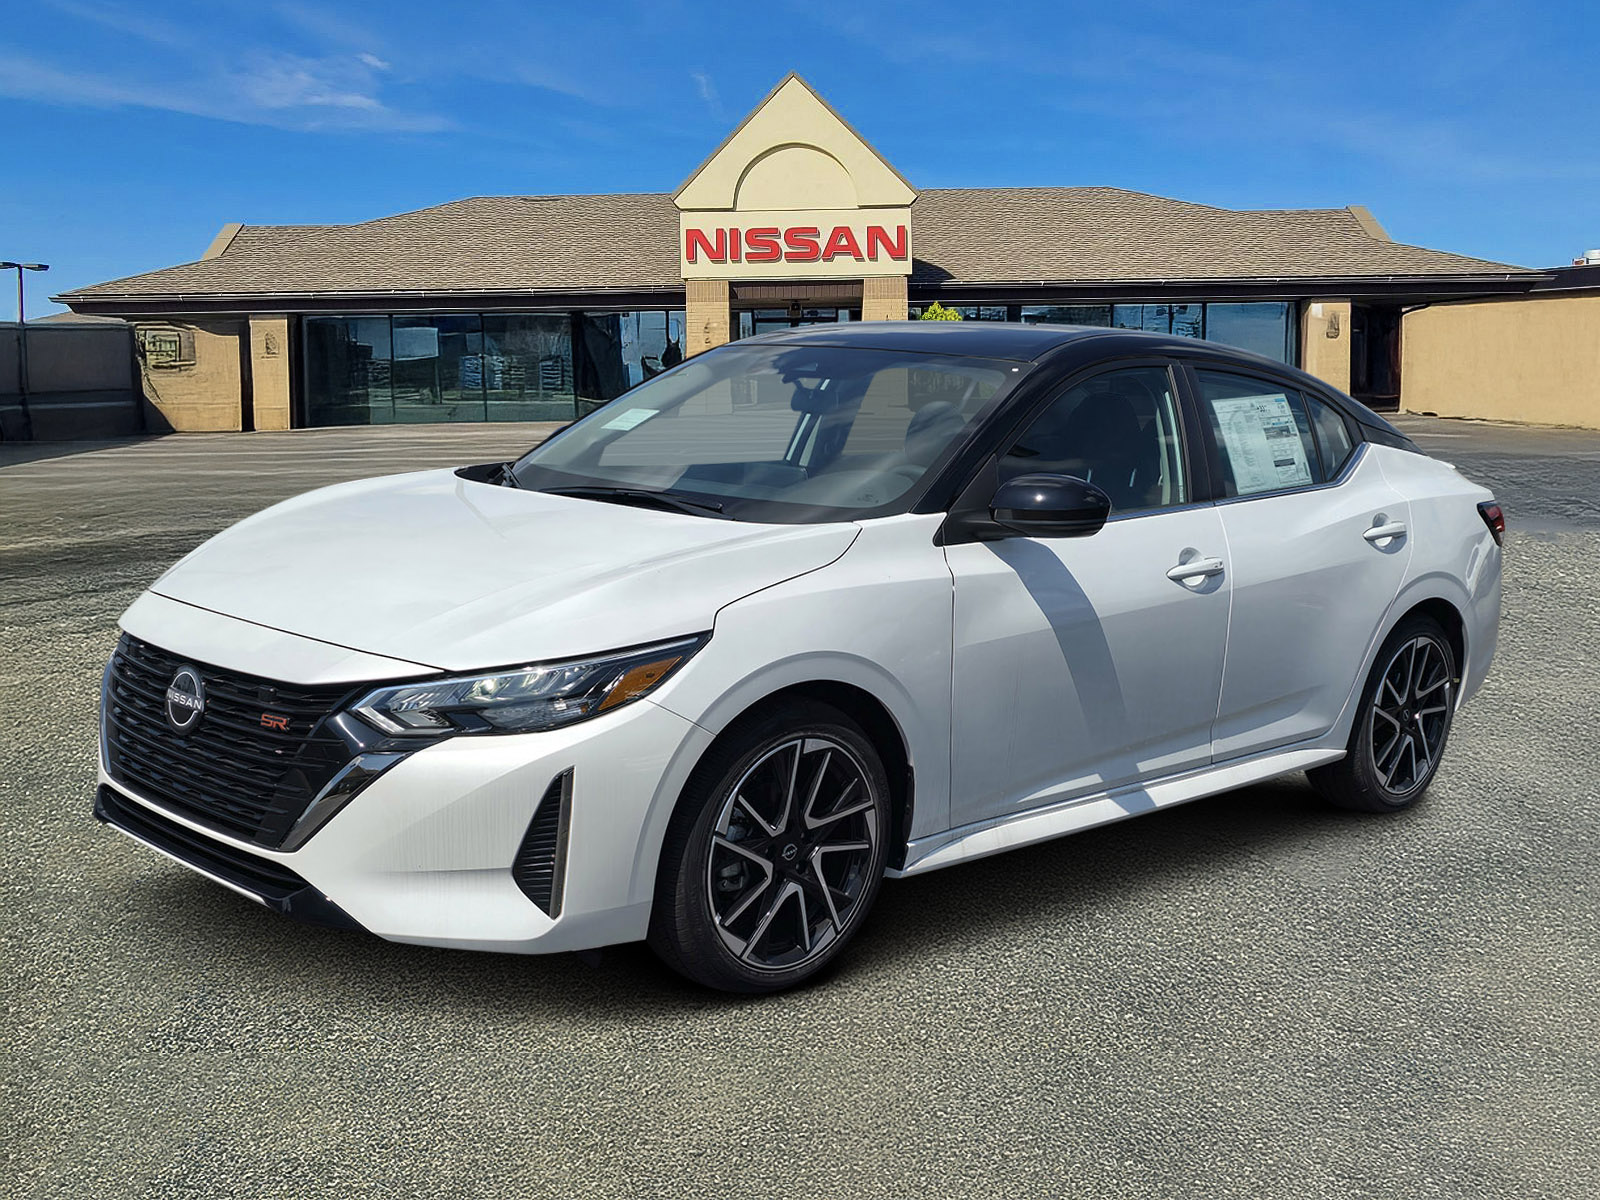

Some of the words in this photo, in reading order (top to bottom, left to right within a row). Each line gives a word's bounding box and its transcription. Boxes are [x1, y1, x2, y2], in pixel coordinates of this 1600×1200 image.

[685, 225, 907, 263] NISSAN
[167, 688, 202, 710] NISSAN
[260, 713, 288, 731] SR
